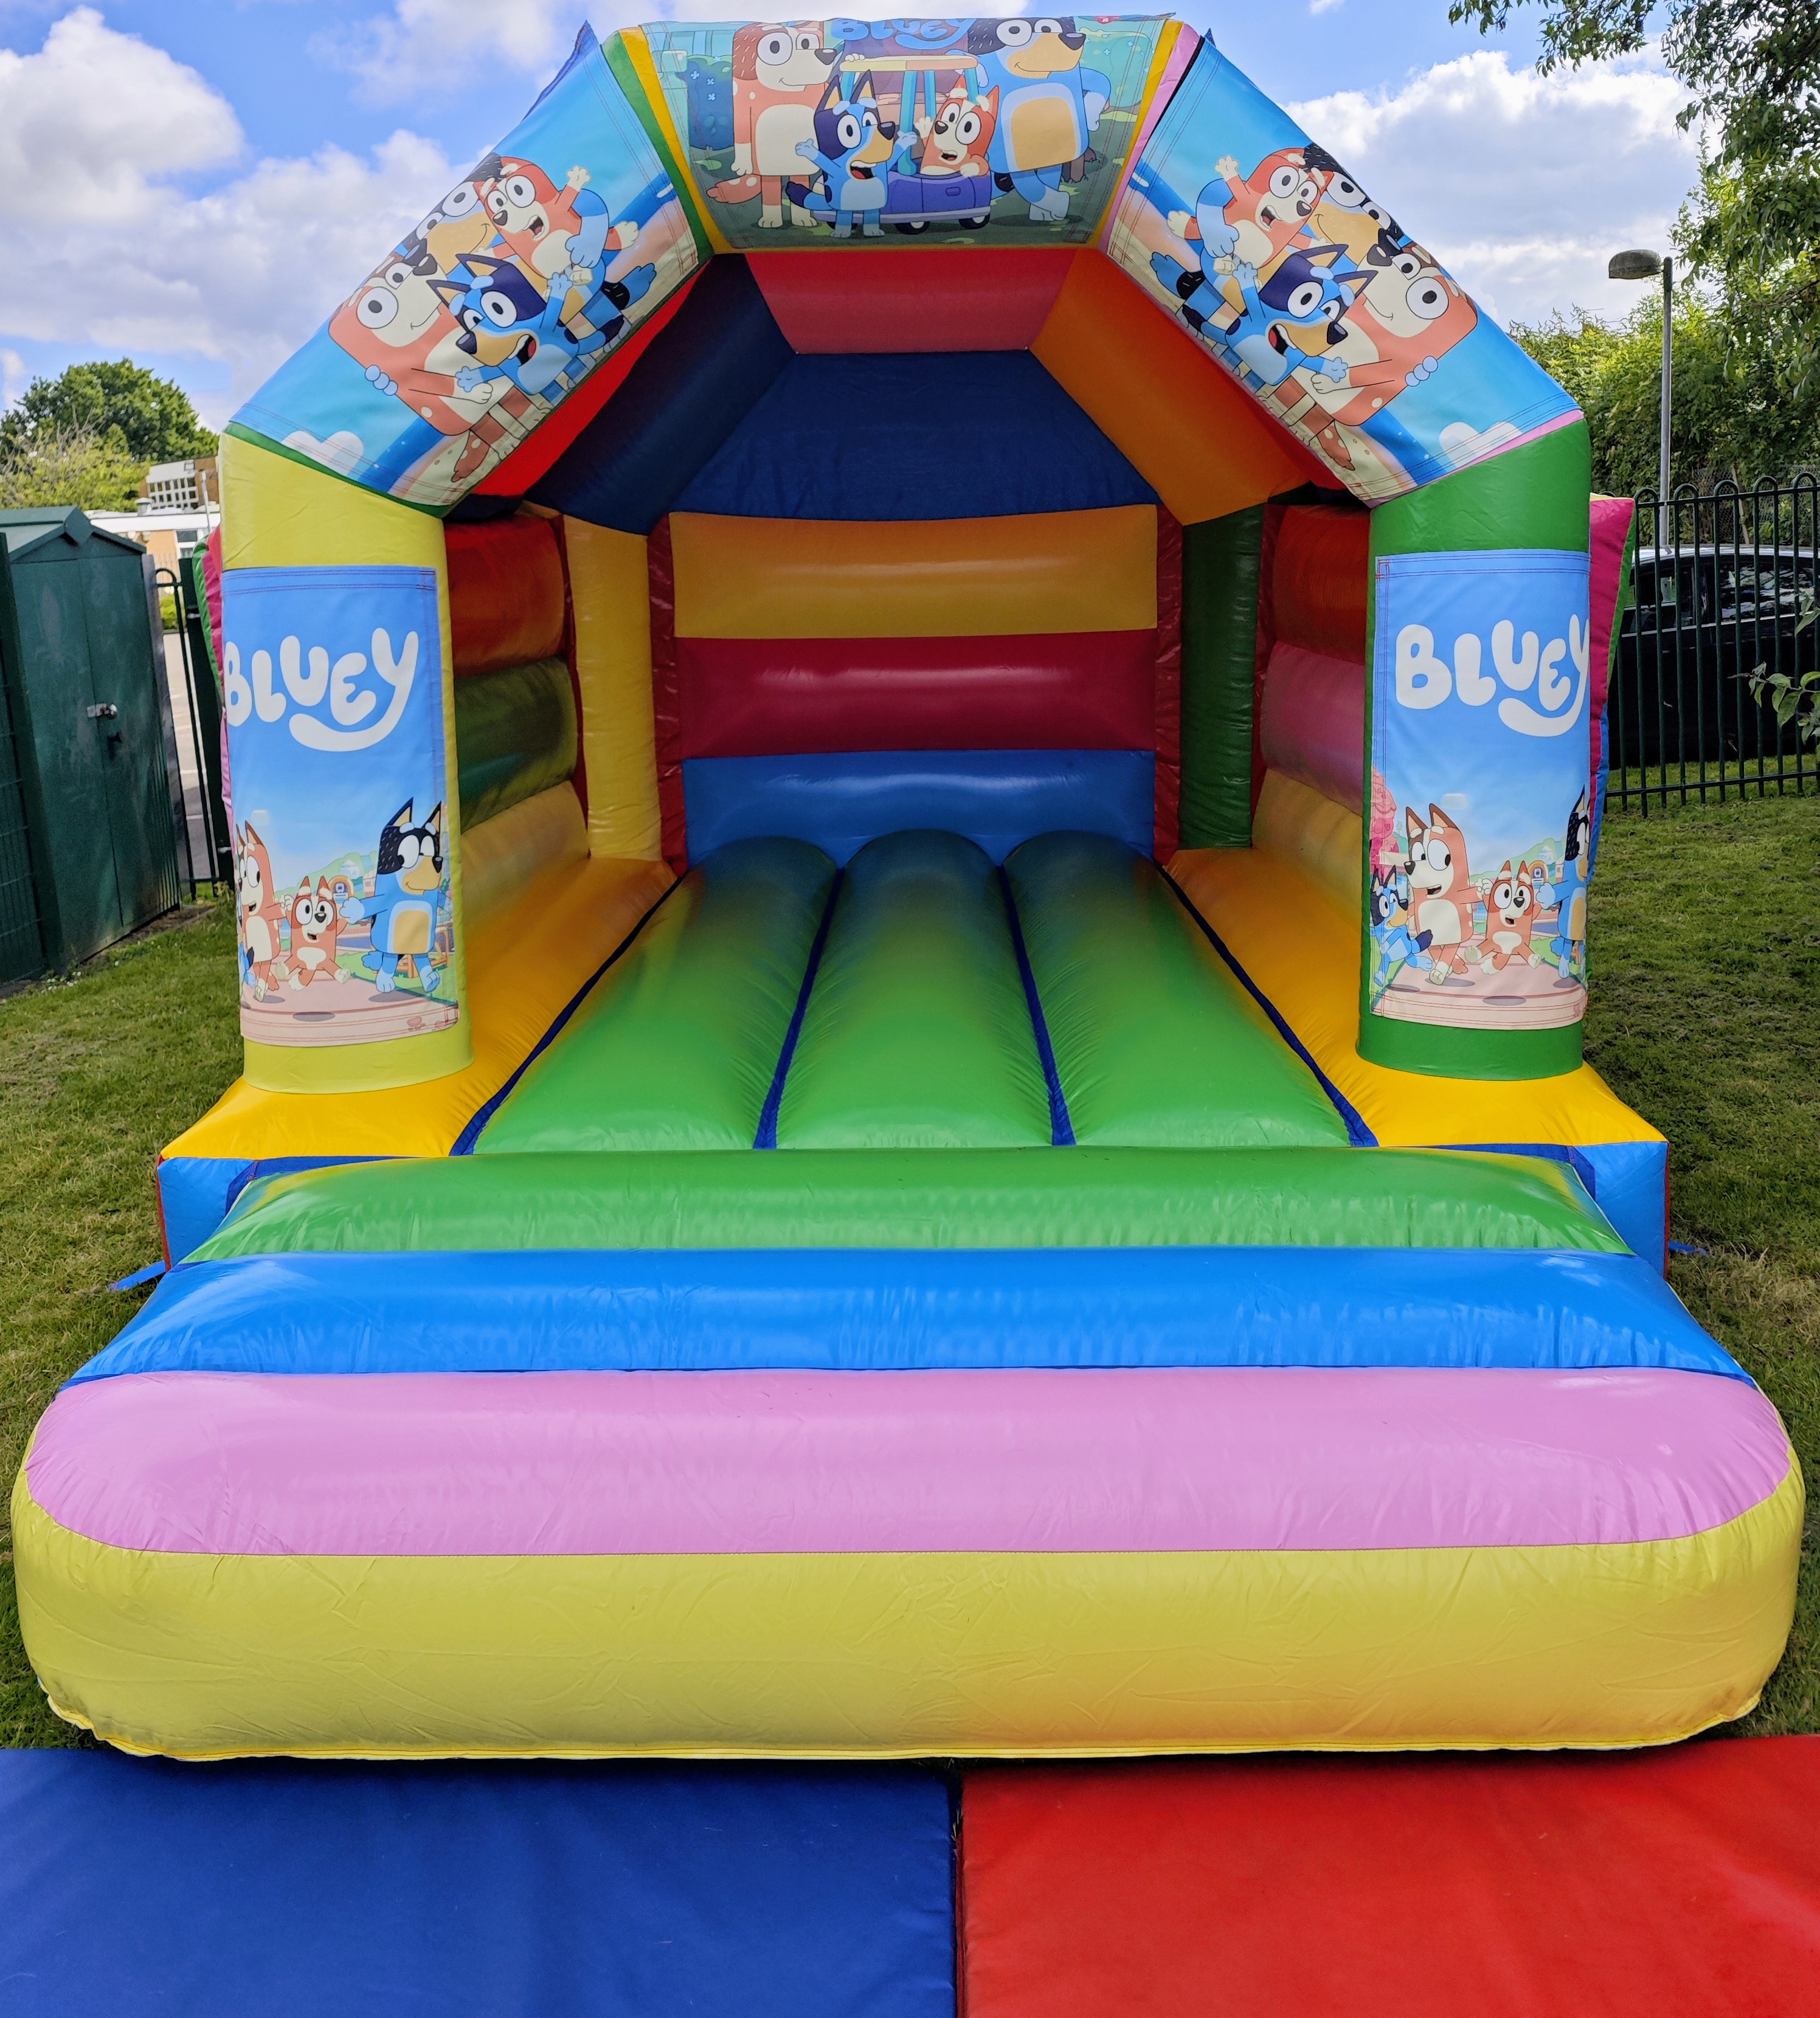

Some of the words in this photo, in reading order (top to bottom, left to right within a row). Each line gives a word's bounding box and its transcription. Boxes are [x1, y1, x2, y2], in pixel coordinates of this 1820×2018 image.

[831, 18, 977, 50] BLUEY
[224, 627, 418, 752] BLUEY
[1396, 614, 1590, 737] BLUEY
